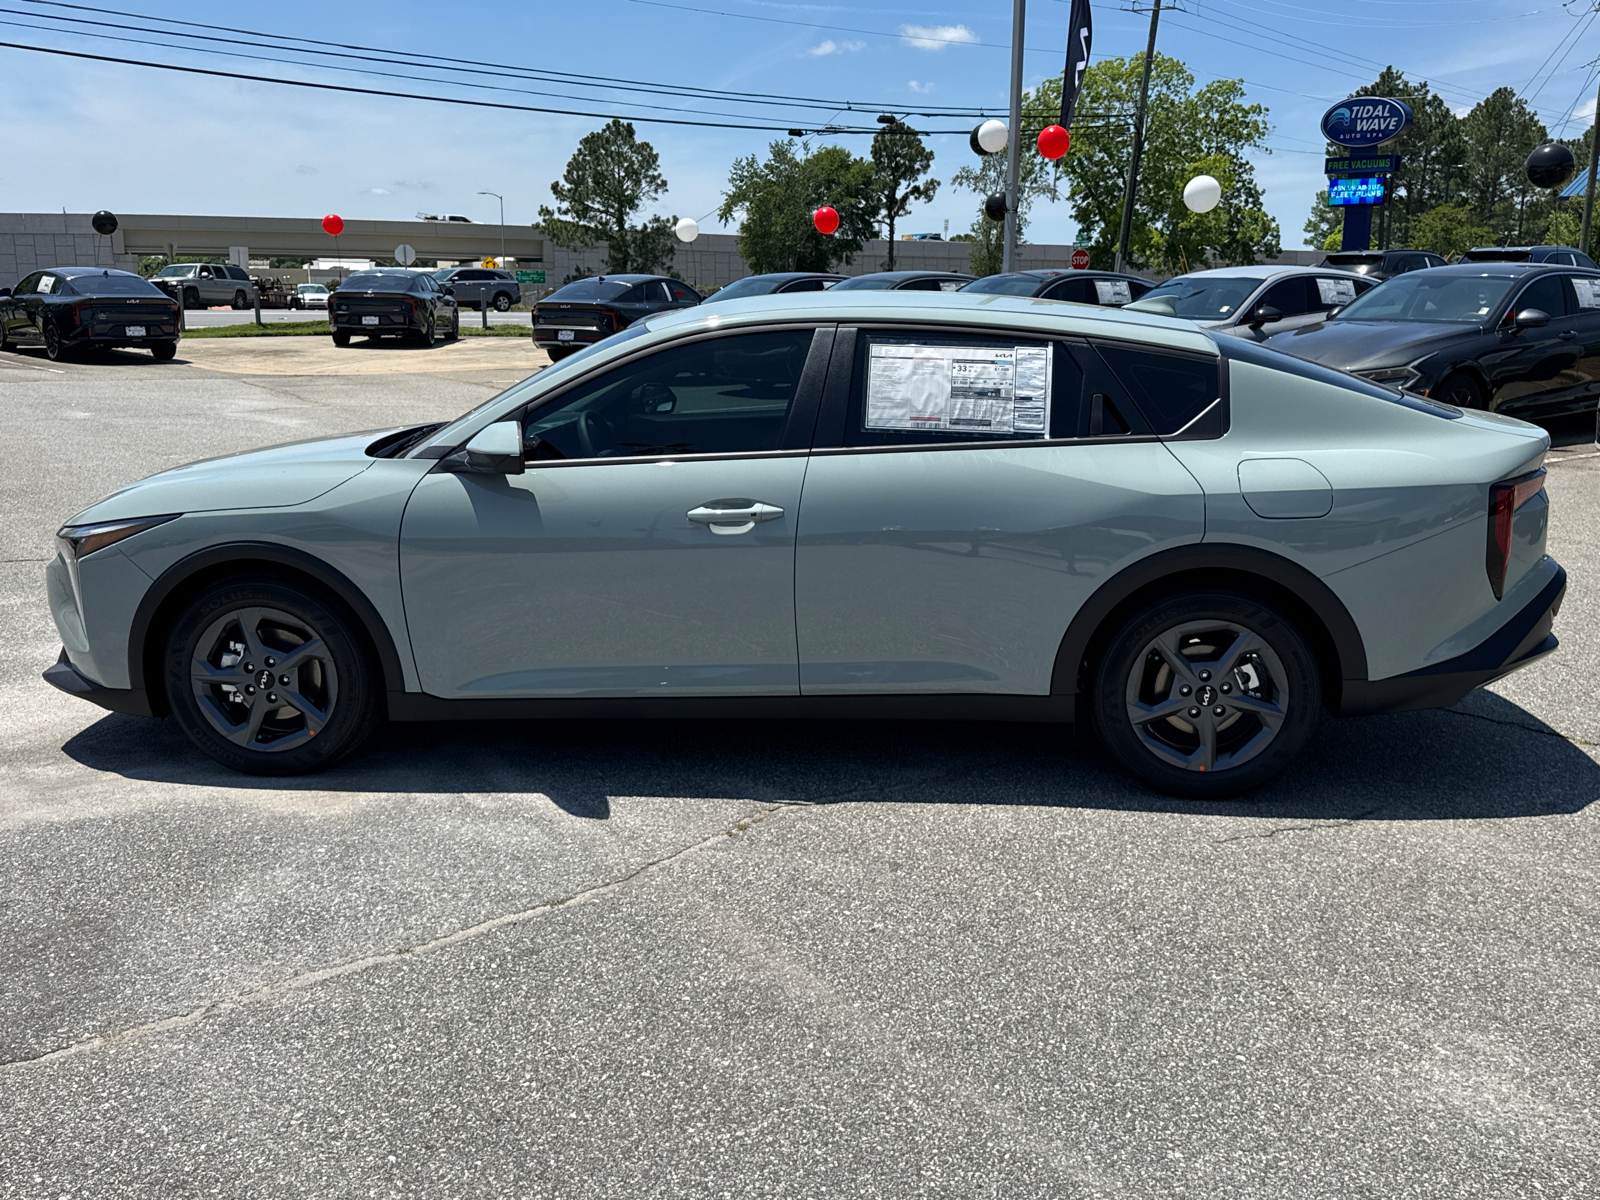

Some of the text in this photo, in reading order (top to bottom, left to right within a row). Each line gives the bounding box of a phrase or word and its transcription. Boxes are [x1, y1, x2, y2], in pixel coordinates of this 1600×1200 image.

[1351, 105, 1390, 118] TIDAL
[1356, 118, 1398, 131] WAVE
[1328, 159, 1390, 170] FREE VACUUMS
[1330, 191, 1354, 199] FLEET
[1072, 255, 1089, 265] STOP
[957, 364, 967, 372] 33
[200, 590, 254, 617] SOLUS
[192, 727, 245, 766] KUMHO
